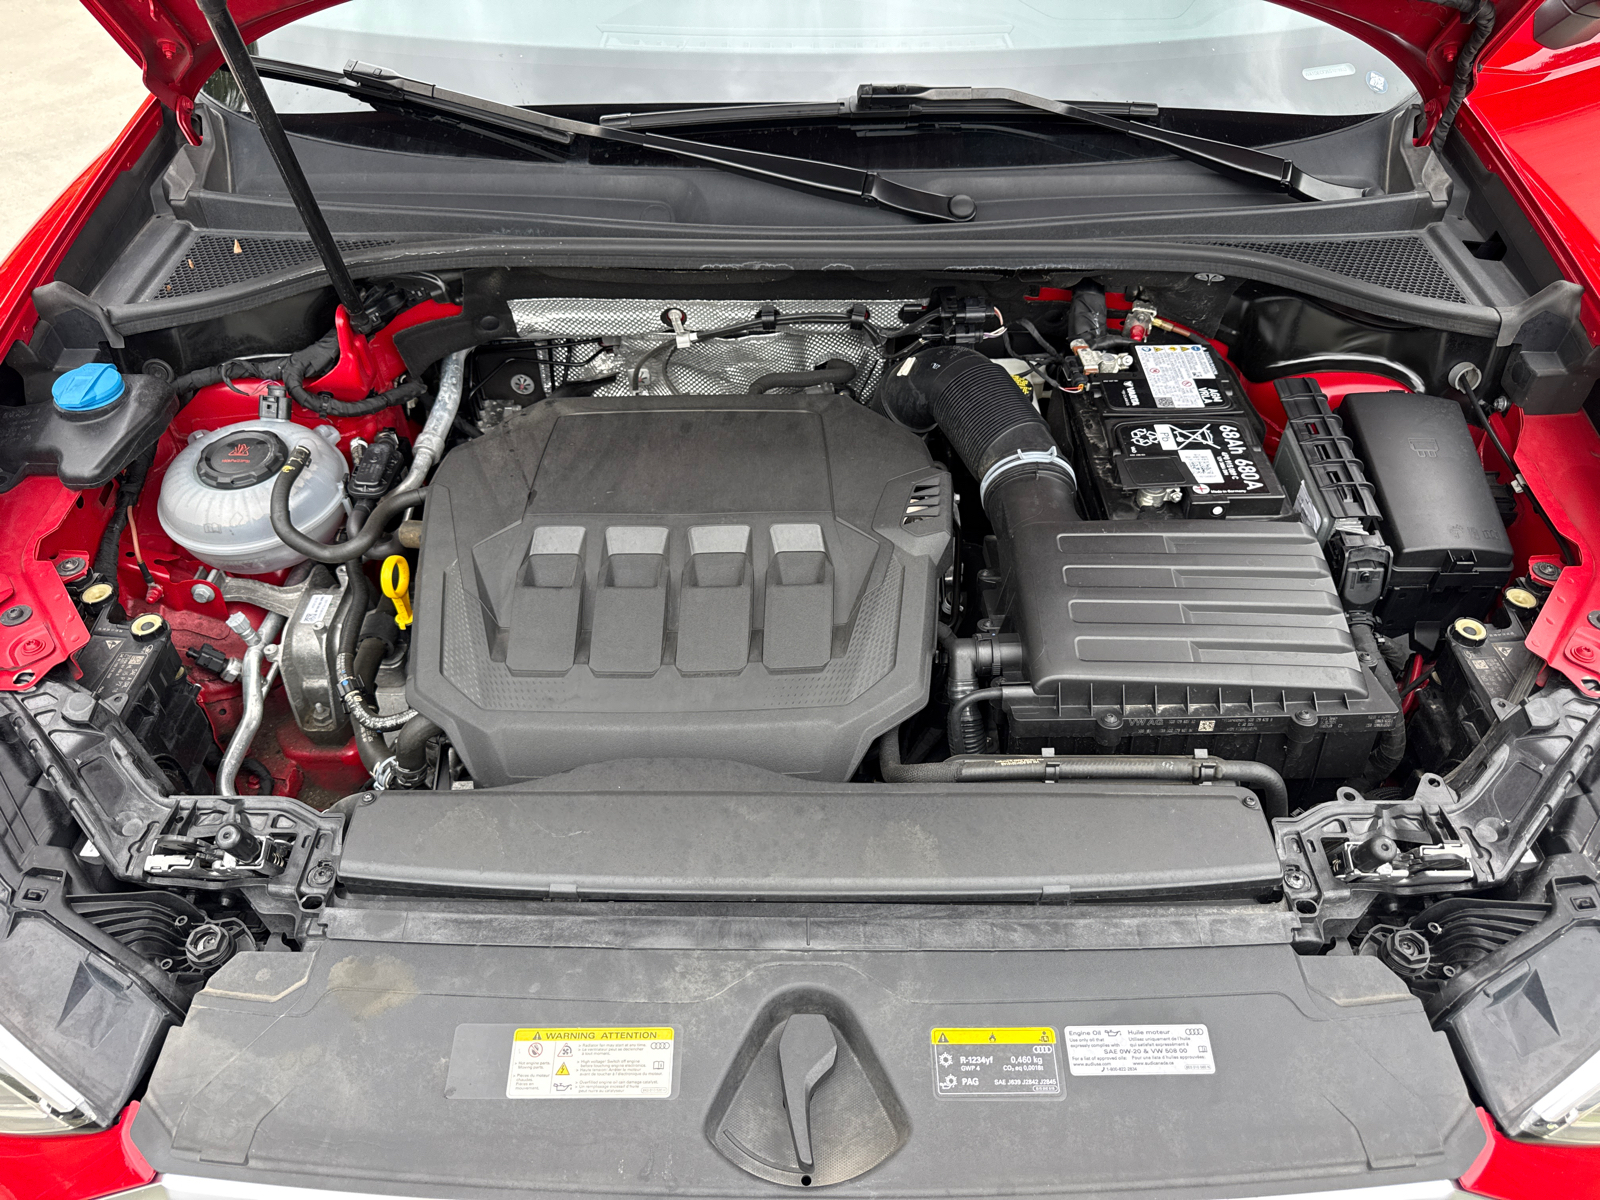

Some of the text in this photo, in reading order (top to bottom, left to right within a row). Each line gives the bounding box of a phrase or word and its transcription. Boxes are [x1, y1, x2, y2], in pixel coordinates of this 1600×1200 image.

[1198, 387, 1212, 403] VRLA
[1208, 388, 1223, 402] AGM
[1160, 432, 1170, 442] Pb
[1219, 425, 1264, 490] 68Ah 680A
[960, 1056, 1042, 1065] R-1234yf 0,460 kg
